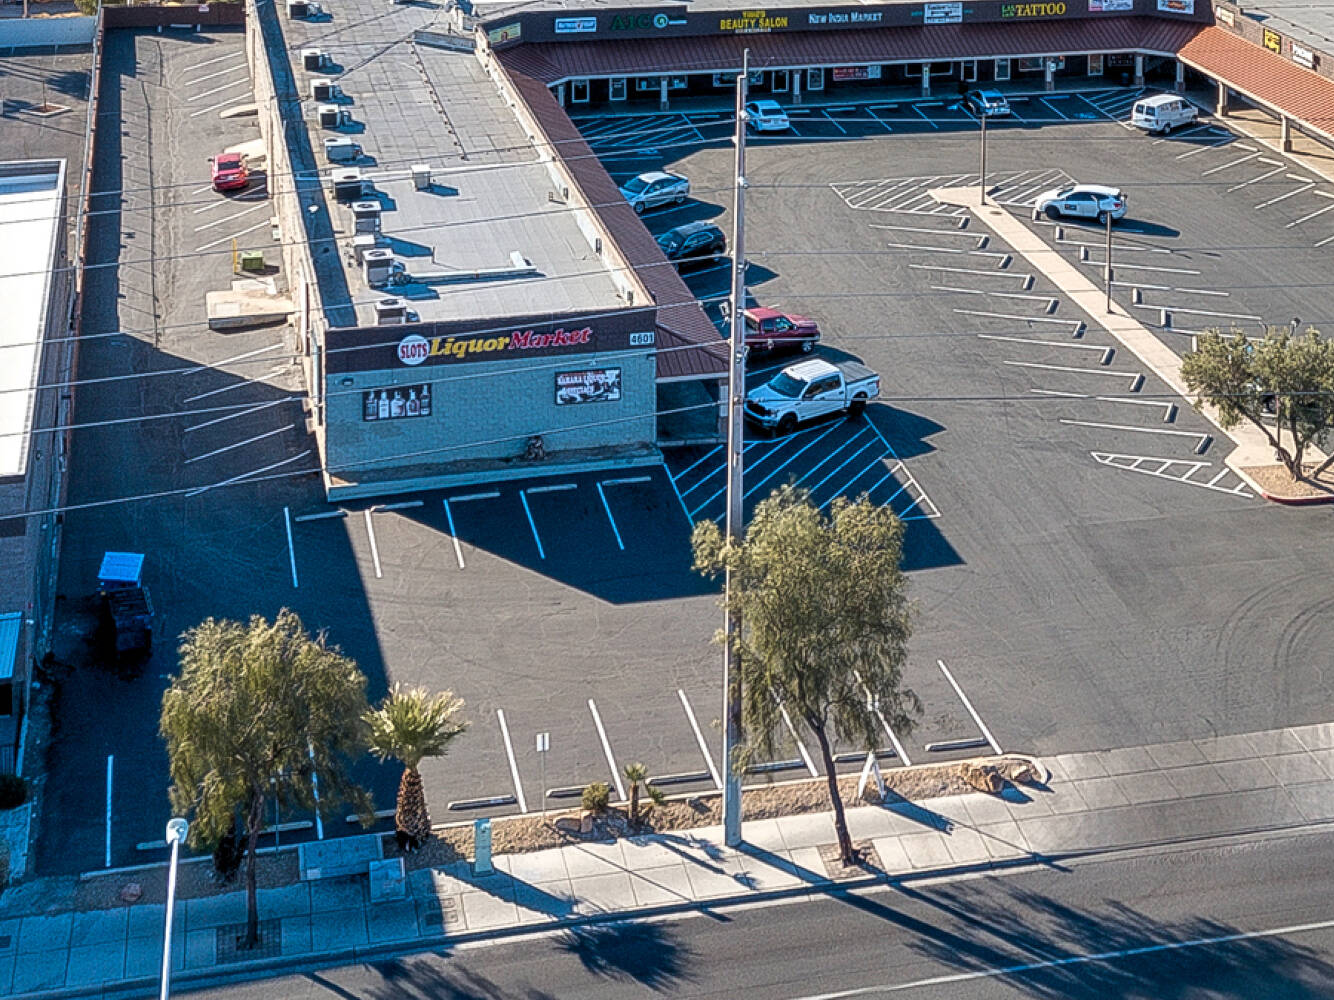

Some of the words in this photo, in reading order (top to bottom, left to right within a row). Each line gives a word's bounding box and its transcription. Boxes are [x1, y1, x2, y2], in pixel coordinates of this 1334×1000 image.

[1015, 2, 1067, 17] TATTOO
[720, 18, 756, 30] BEAUTY
[758, 16, 788, 29] SALON
[428, 337, 511, 358] Liquor
[508, 327, 593, 351] Market
[400, 343, 428, 361] SLOTS
